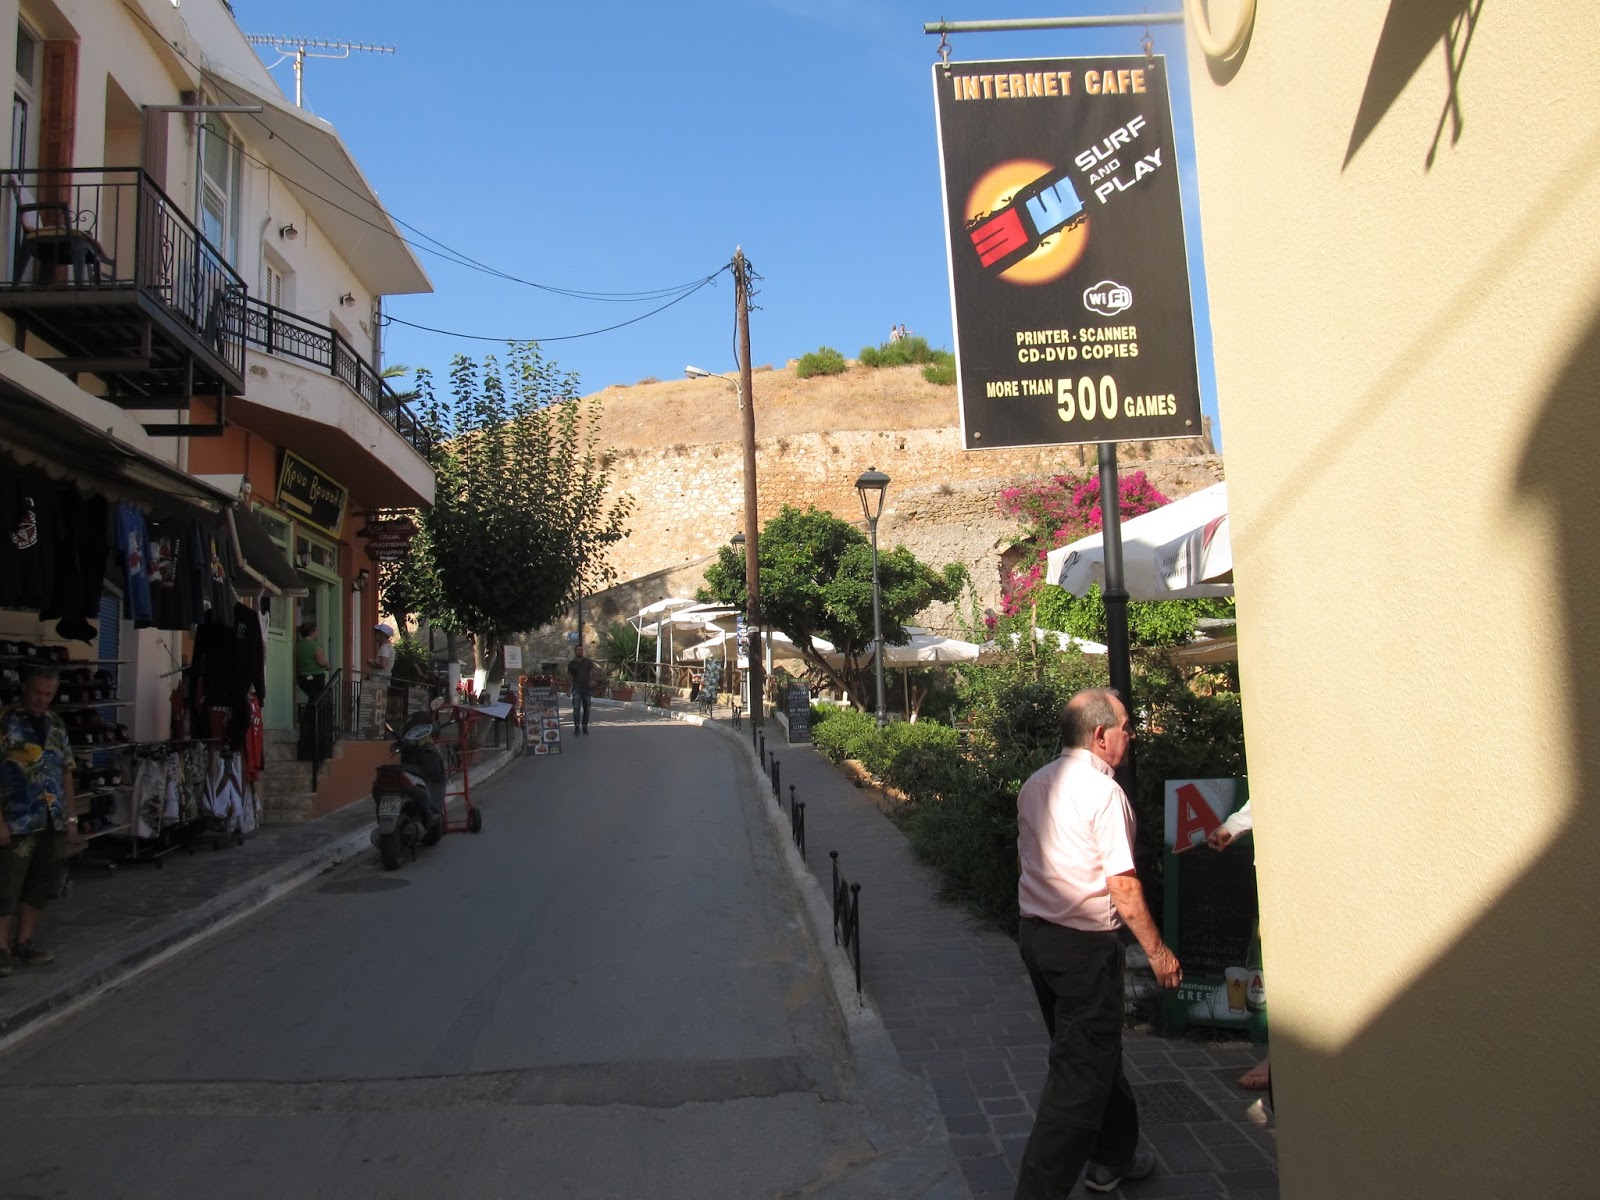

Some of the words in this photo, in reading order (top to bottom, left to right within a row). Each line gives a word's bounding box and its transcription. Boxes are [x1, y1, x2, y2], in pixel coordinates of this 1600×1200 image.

[953, 71, 1072, 101] INTERNET
[1084, 69, 1147, 95] CAFE
[1074, 115, 1147, 172] SURF
[1088, 158, 1121, 185] AND
[1094, 147, 1162, 204] PLAY
[1016, 329, 1069, 346] PRINTER
[1079, 325, 1137, 343] SCANNER
[1018, 346, 1078, 363] CD-DVD
[1081, 343, 1139, 359] COPIES
[986, 381, 1020, 398] MORE
[1021, 378, 1053, 396] THAN
[1057, 374, 1119, 422] 500
[1124, 394, 1177, 418] GAMES
